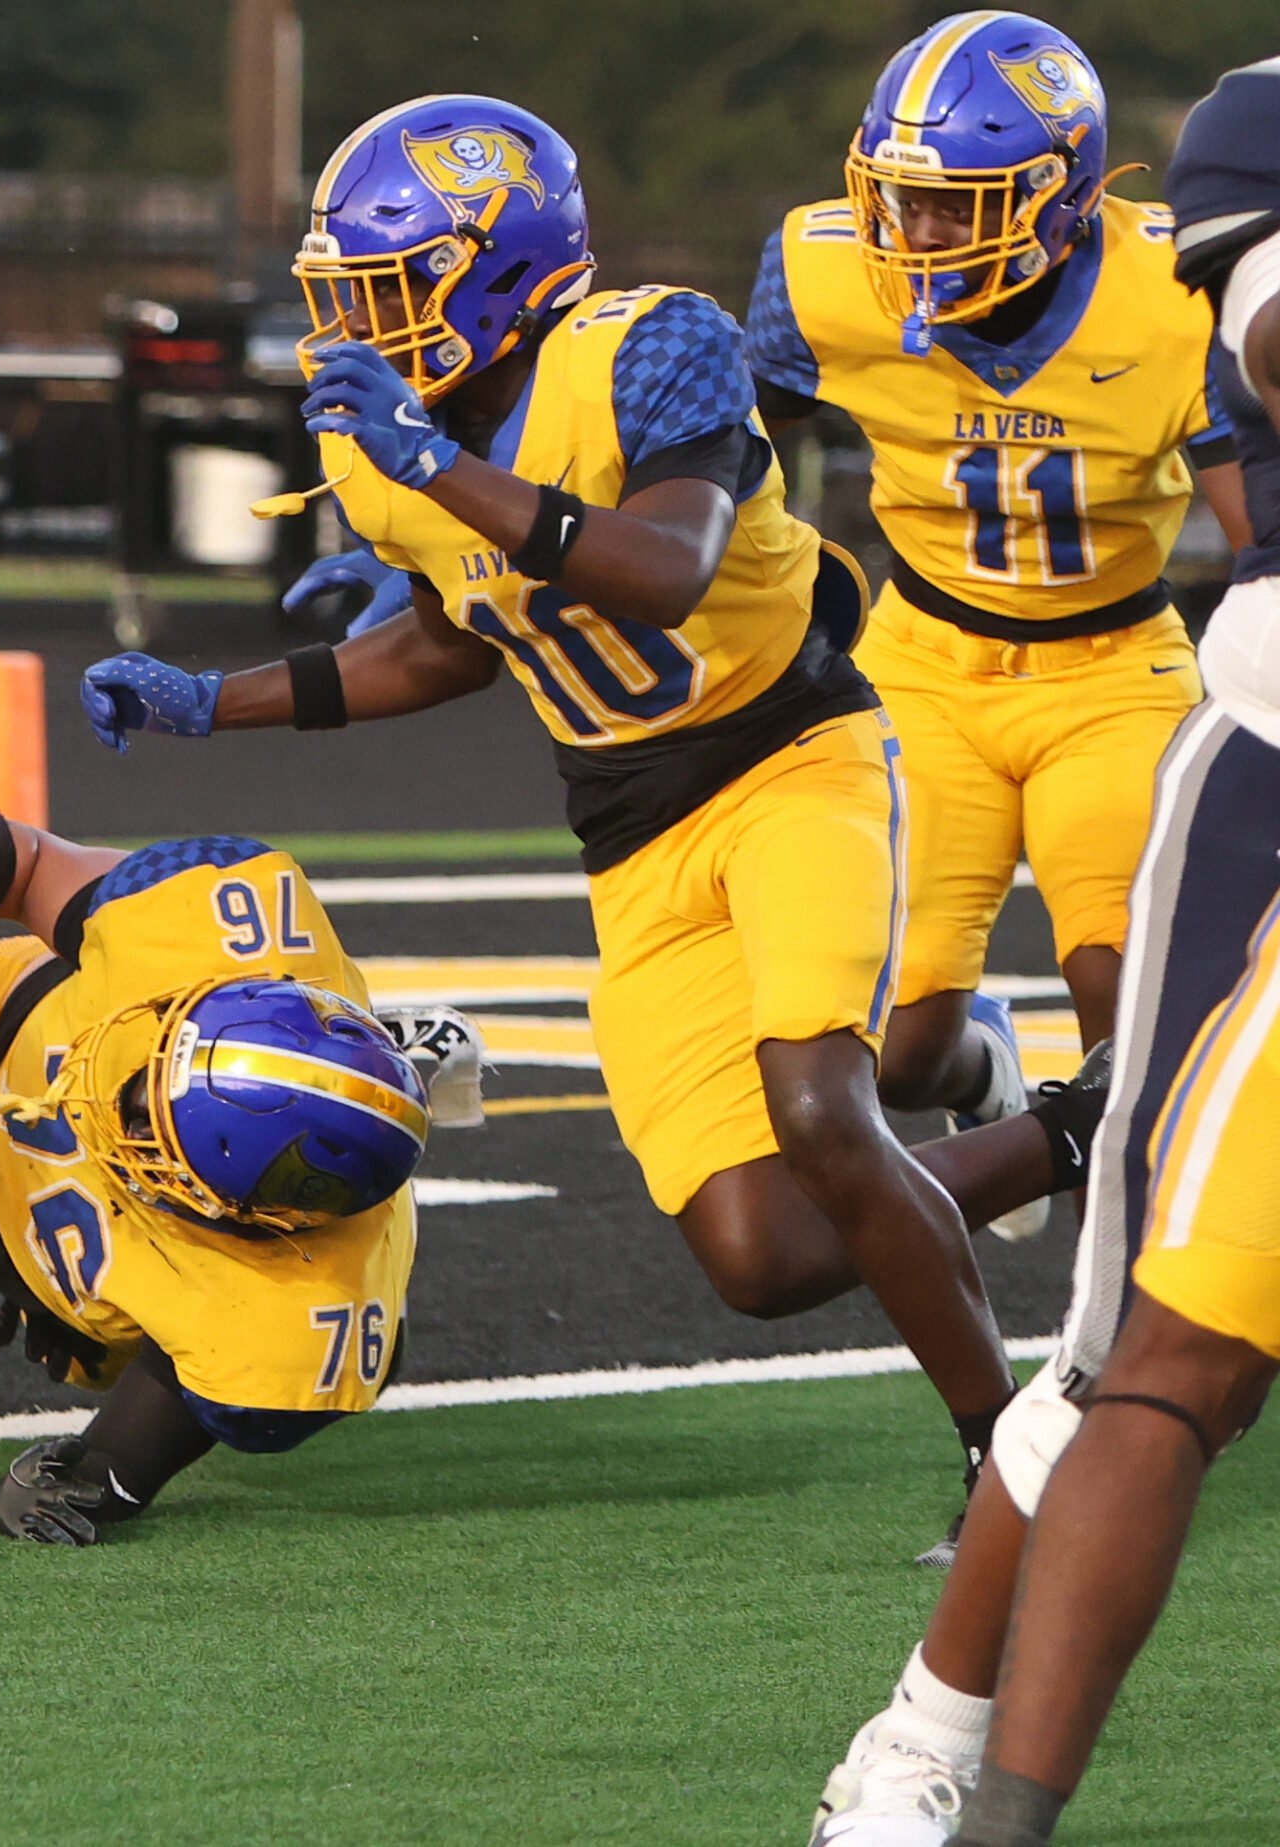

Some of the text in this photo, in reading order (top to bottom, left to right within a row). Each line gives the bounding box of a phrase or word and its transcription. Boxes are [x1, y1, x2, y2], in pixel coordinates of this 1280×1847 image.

[955, 413, 1066, 439] LA VEGA
[941, 444, 1097, 587] 11
[460, 553, 489, 581] LA
[459, 579, 707, 746] 10
[210, 870, 317, 962] 76
[309, 1298, 388, 1391] 76
